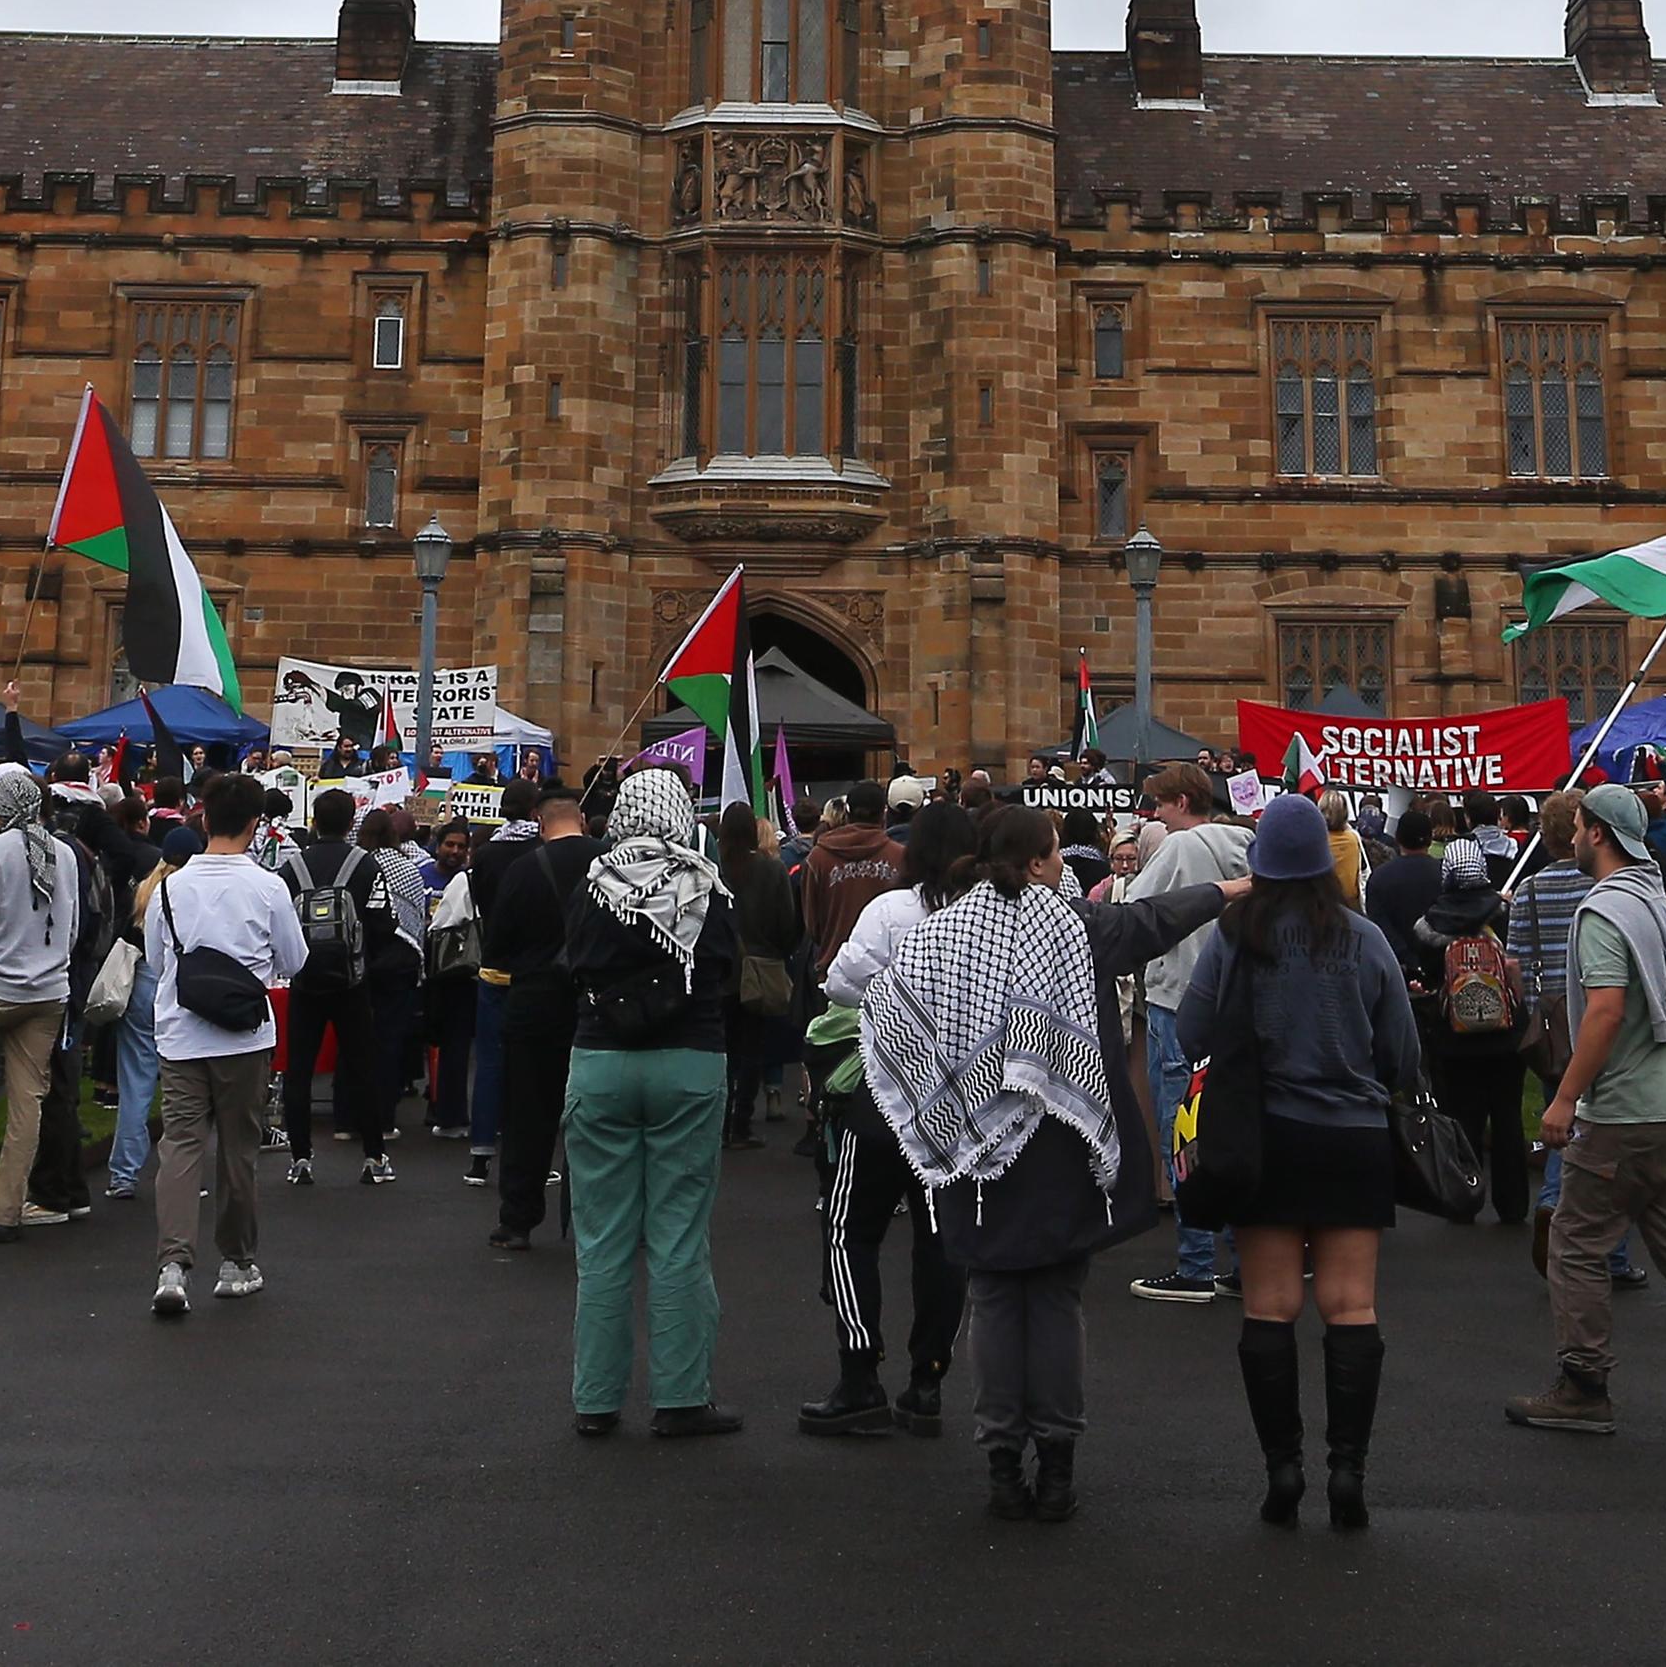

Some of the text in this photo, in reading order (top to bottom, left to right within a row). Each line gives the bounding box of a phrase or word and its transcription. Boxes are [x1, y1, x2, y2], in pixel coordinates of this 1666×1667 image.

[370, 670, 488, 685] ISRAL IS A
[390, 686, 497, 702] TERORIS
[444, 727, 491, 736] ALTERNATIVE
[1321, 725, 1481, 757] SOCIALIST
[1325, 754, 1504, 788] LTERNATIVE
[452, 791, 491, 804] WITH
[1023, 788, 1135, 808] UNIONIS
